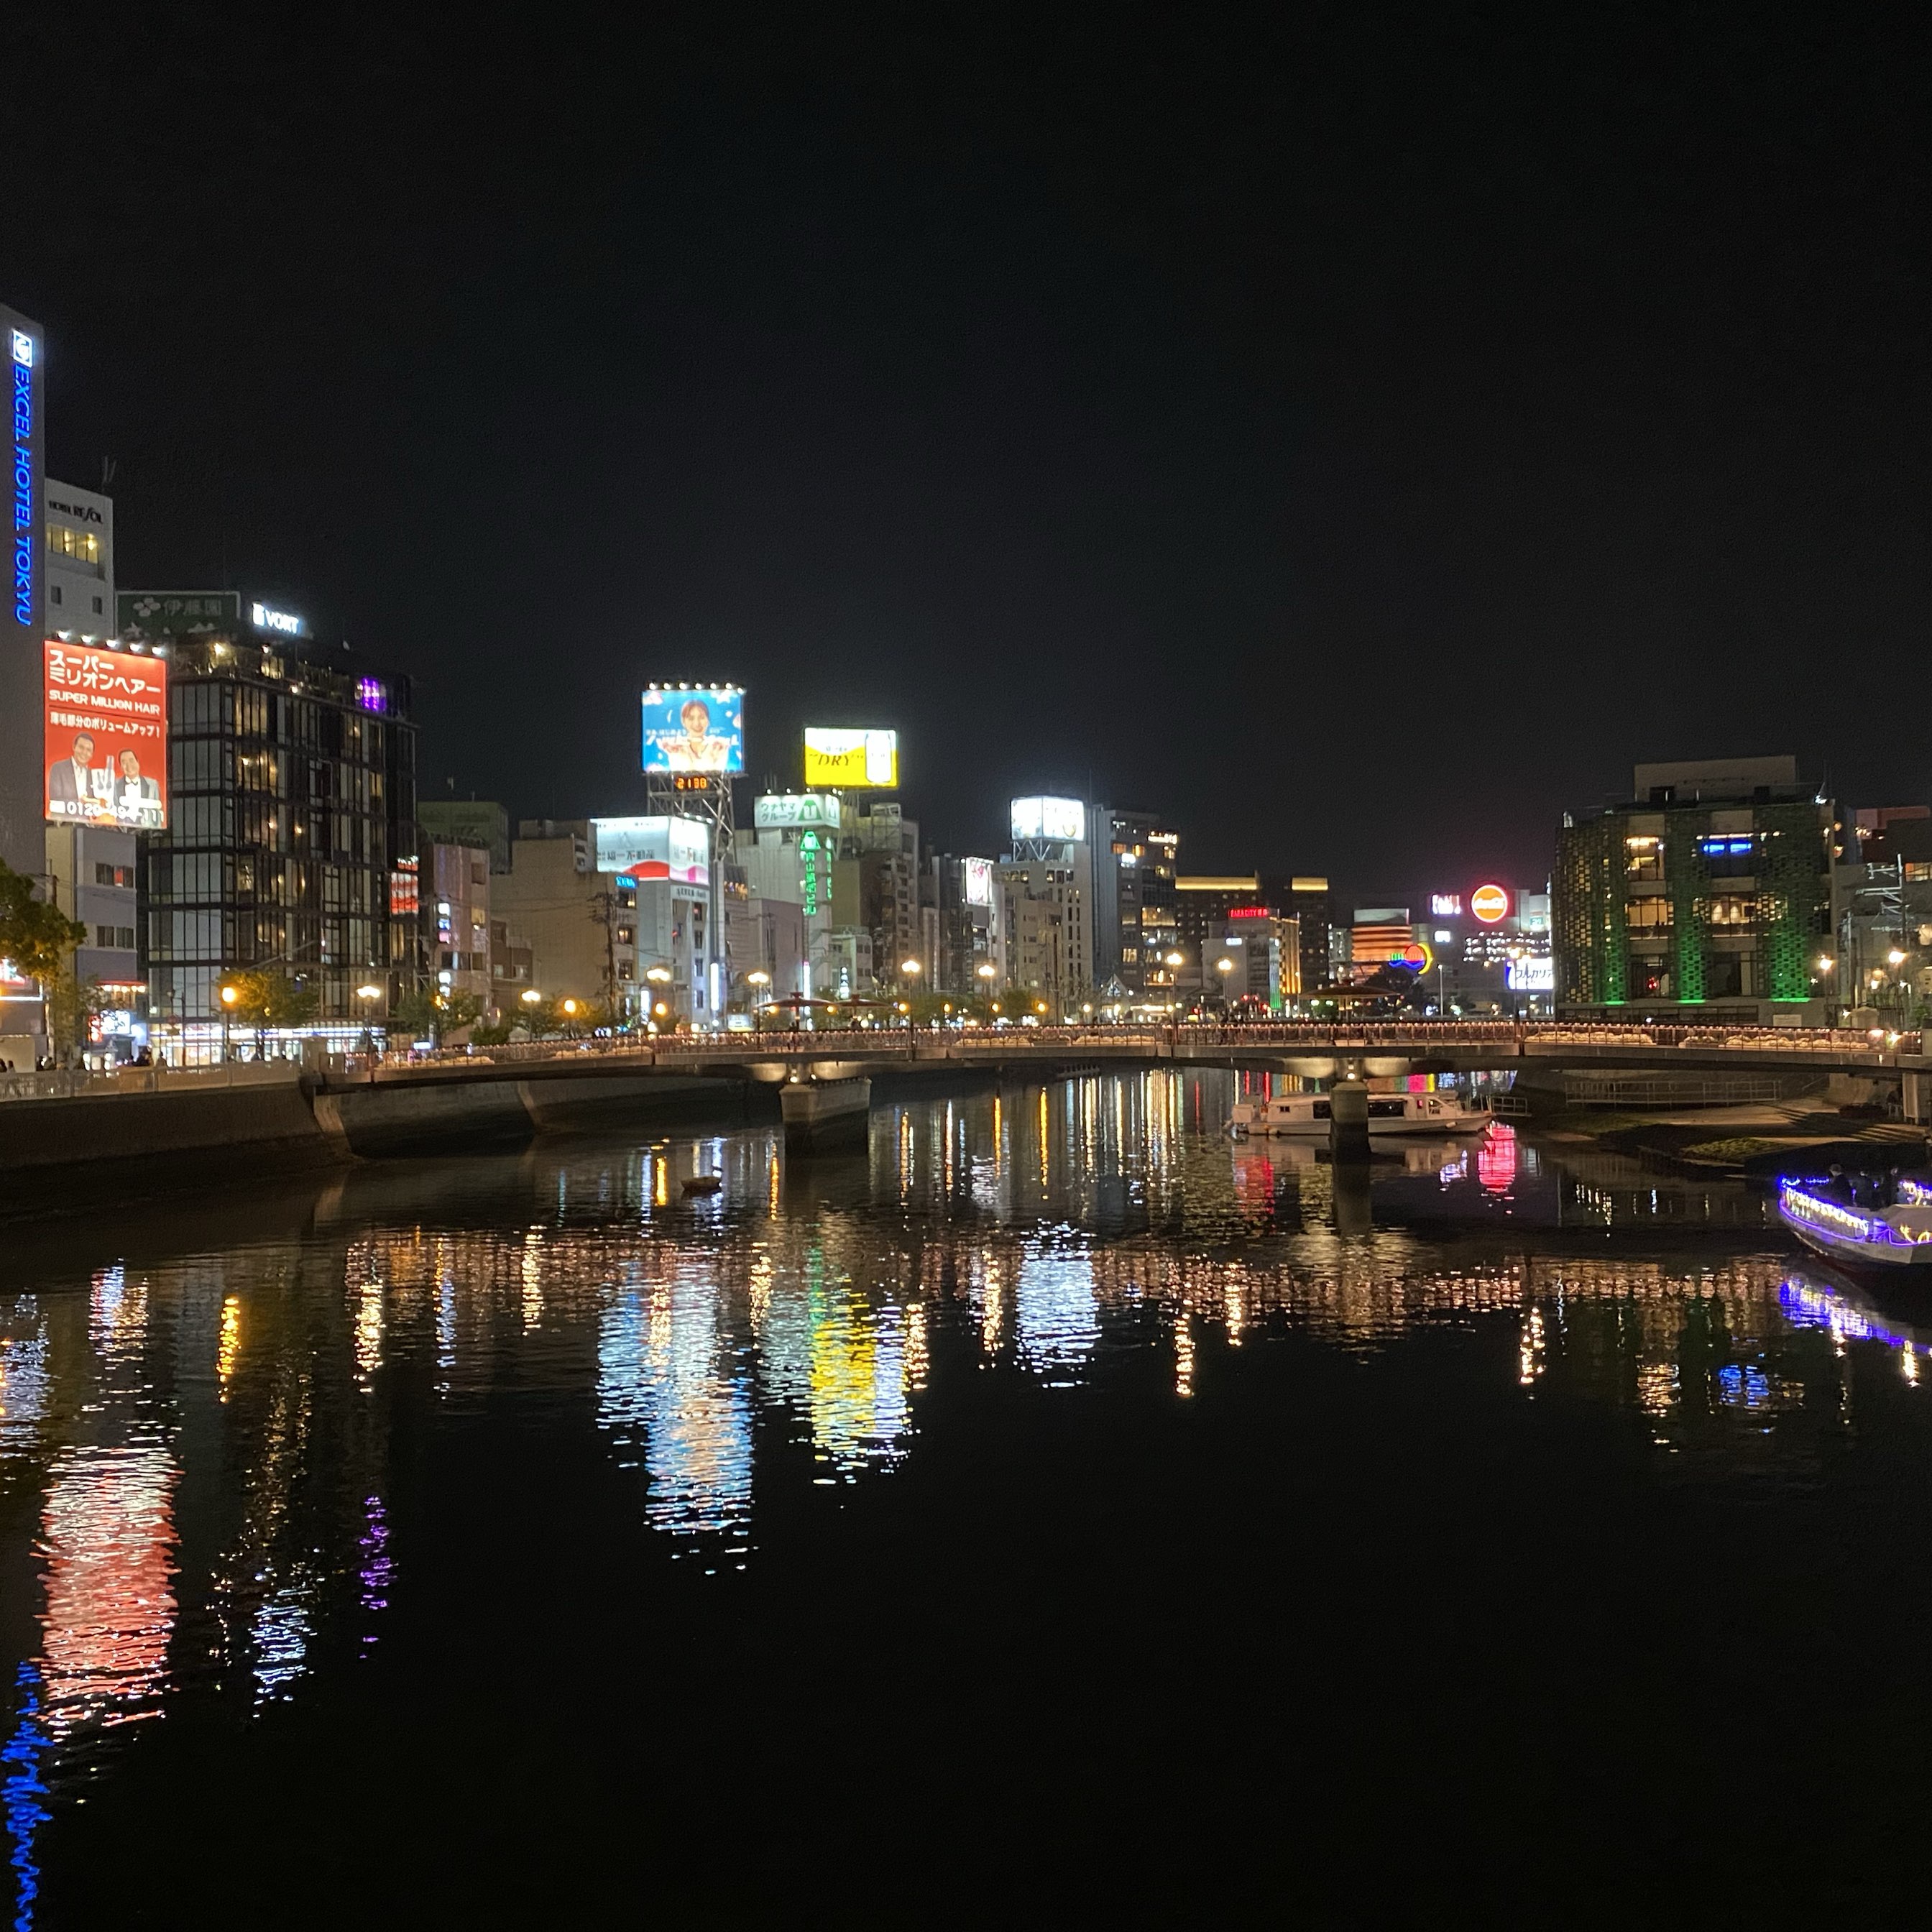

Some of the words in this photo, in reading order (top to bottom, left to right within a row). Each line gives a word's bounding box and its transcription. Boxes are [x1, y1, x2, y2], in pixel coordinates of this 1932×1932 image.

[15, 364, 30, 442] EXCEL
[15, 444, 31, 531] HOTEL
[16, 536, 32, 626] TOKYU
[49, 648, 115, 673] スーパー
[49, 666, 162, 695] ミリオンヘアー
[49, 689, 88, 705] SUPER
[91, 695, 133, 712] MILLION
[134, 702, 161, 716] HAIR
